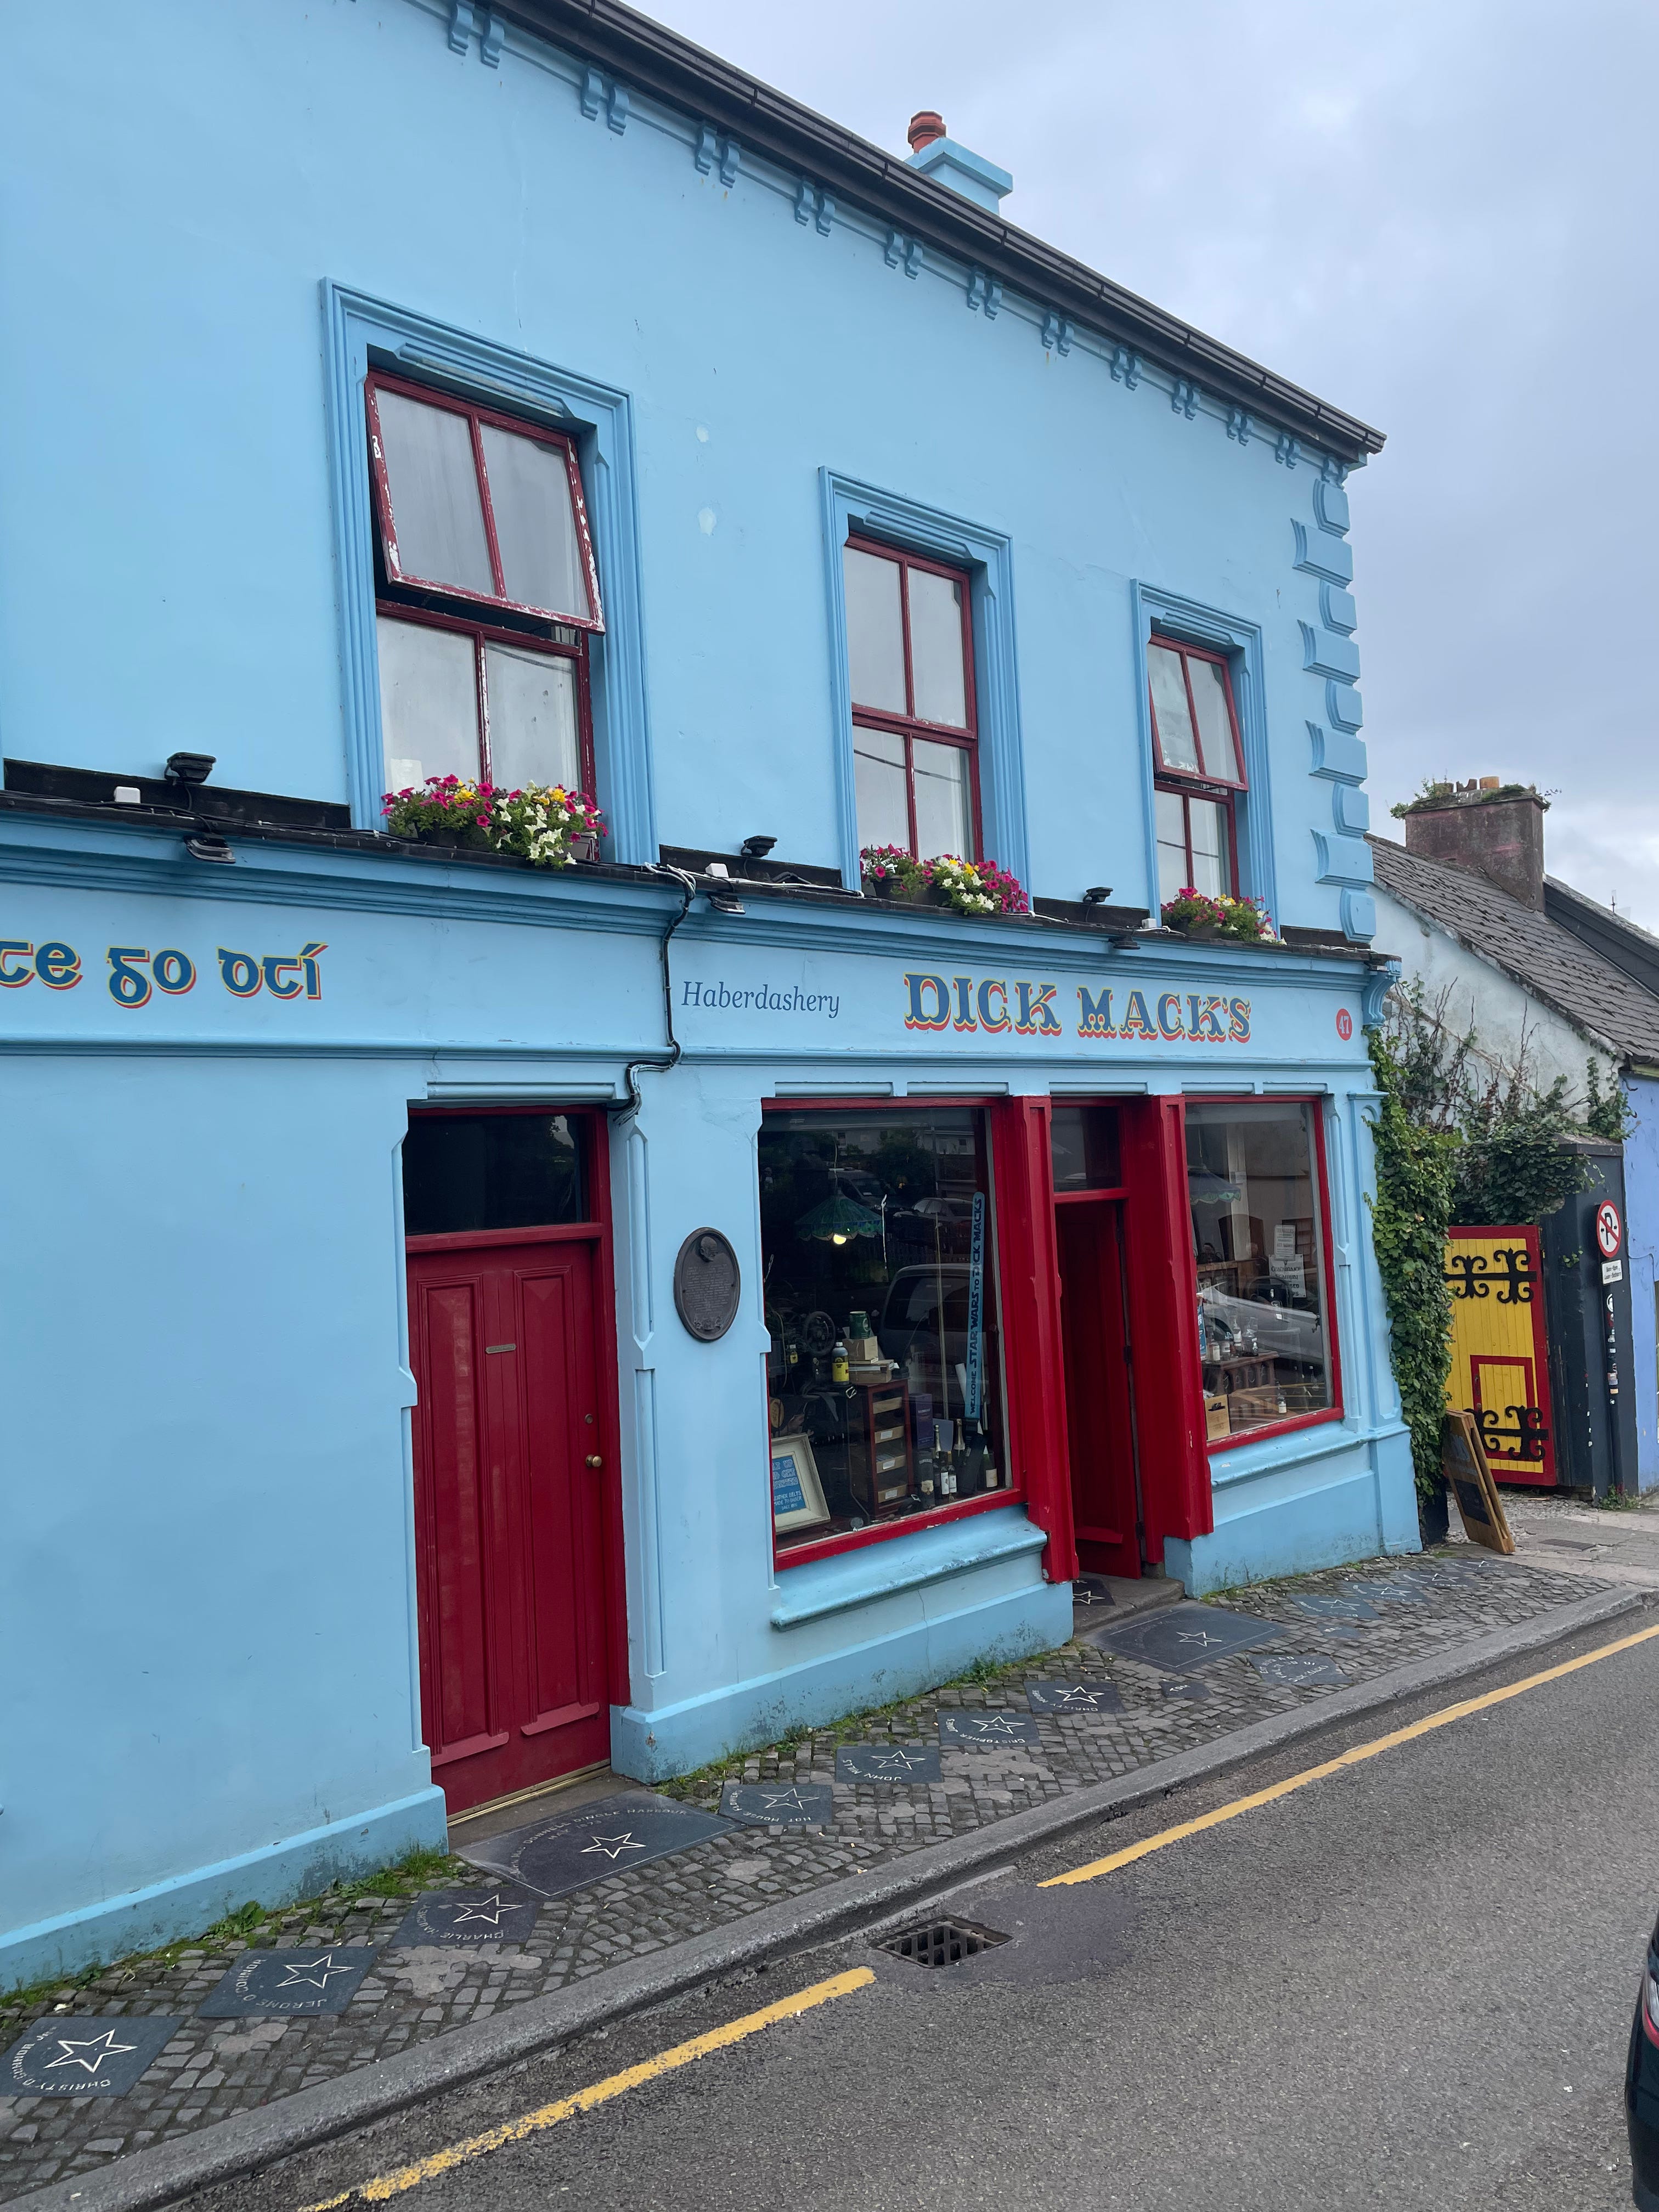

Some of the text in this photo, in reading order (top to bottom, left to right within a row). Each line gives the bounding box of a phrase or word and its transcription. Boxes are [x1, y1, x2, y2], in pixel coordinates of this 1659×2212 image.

[681, 981, 840, 1019] Haberdashery
[904, 972, 1251, 1043] DICK MACK'S
[1339, 1015, 1350, 1034] 47
[973, 1198, 982, 1243] MACKS
[974, 1279, 979, 1291] TO
[970, 1291, 979, 1330] WARS
[969, 1330, 978, 1368] STAR
[864, 1773, 902, 1781] JOHN
[440, 1929, 504, 1940] CHARLIE
[256, 1999, 327, 2009] JEROME
[35, 2079, 111, 2091] CHRISTY
